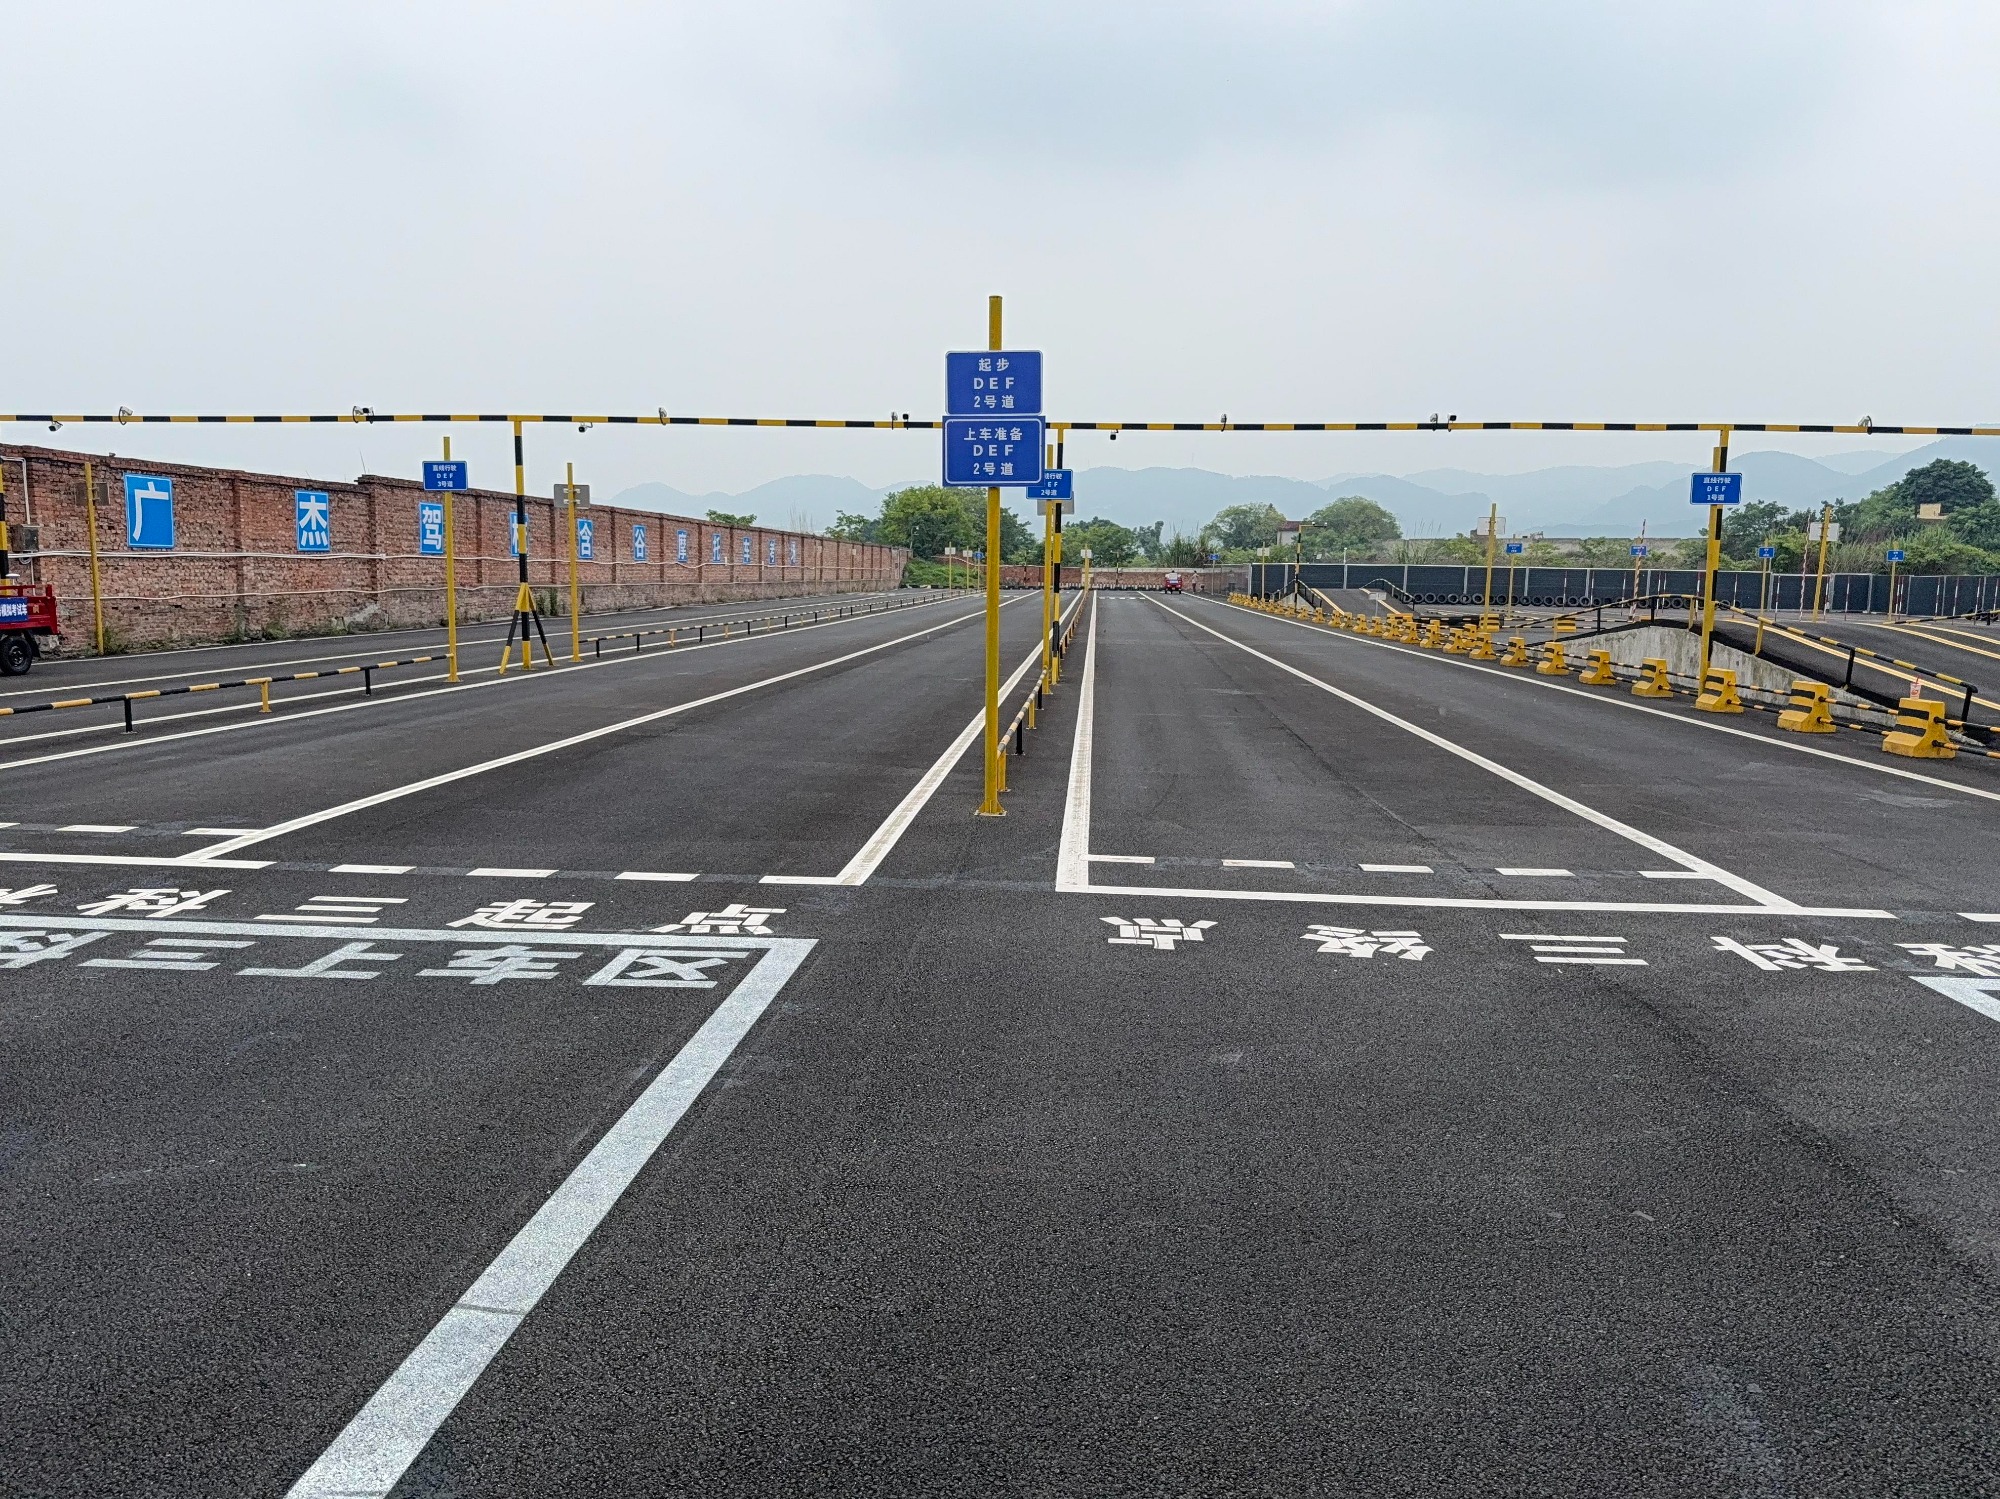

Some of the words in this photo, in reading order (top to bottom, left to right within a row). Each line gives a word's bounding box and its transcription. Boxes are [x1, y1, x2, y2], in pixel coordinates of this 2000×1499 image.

[978, 357, 1010, 372] 起步
[974, 395, 1015, 409] 2号道
[964, 427, 1023, 441] 上车准备
[432, 464, 457, 472] 直线行驶
[973, 462, 1014, 476] 2号道
